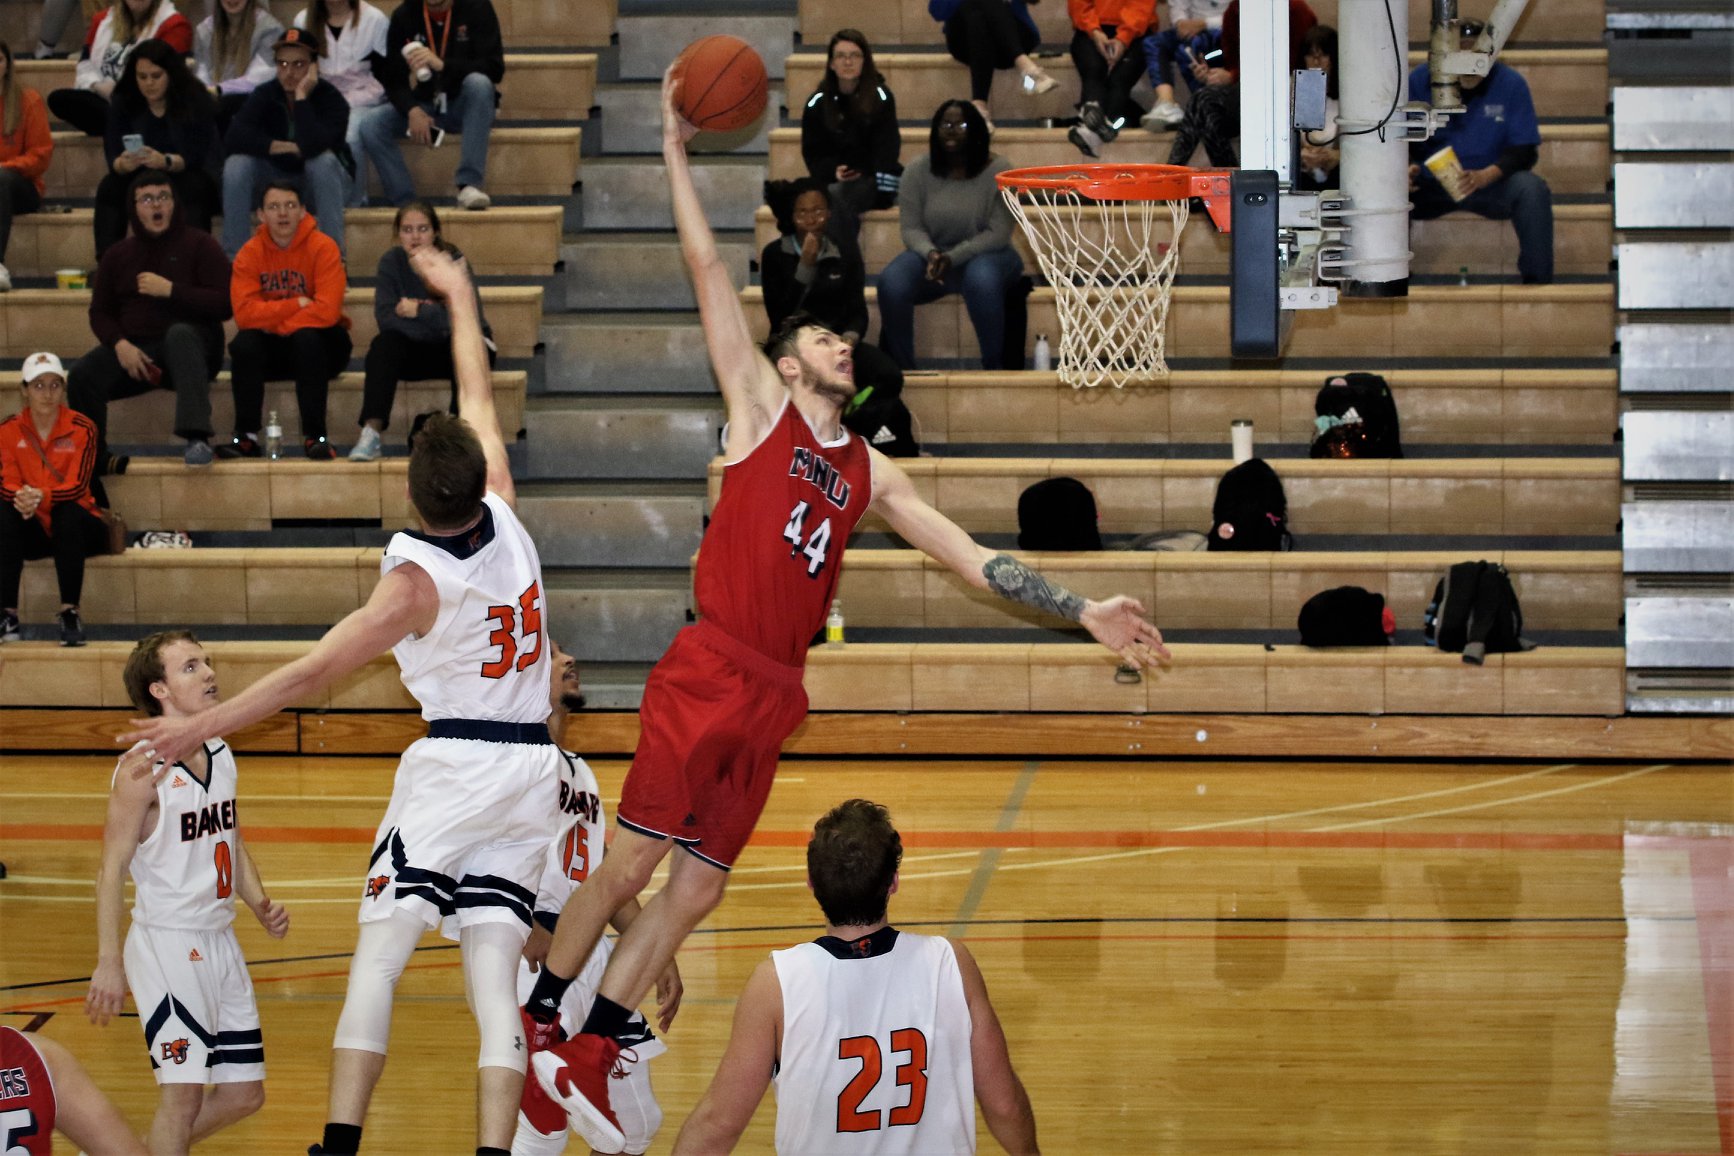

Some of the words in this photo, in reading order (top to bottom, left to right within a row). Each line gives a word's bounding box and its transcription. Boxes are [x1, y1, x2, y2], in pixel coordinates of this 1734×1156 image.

[788, 446, 851, 511] MNU
[783, 499, 831, 579] 44
[481, 580, 541, 679] 35
[213, 840, 232, 900] 0
[562, 820, 590, 884] 15
[0, 1066, 31, 1100] RS
[836, 1027, 929, 1134] 23
